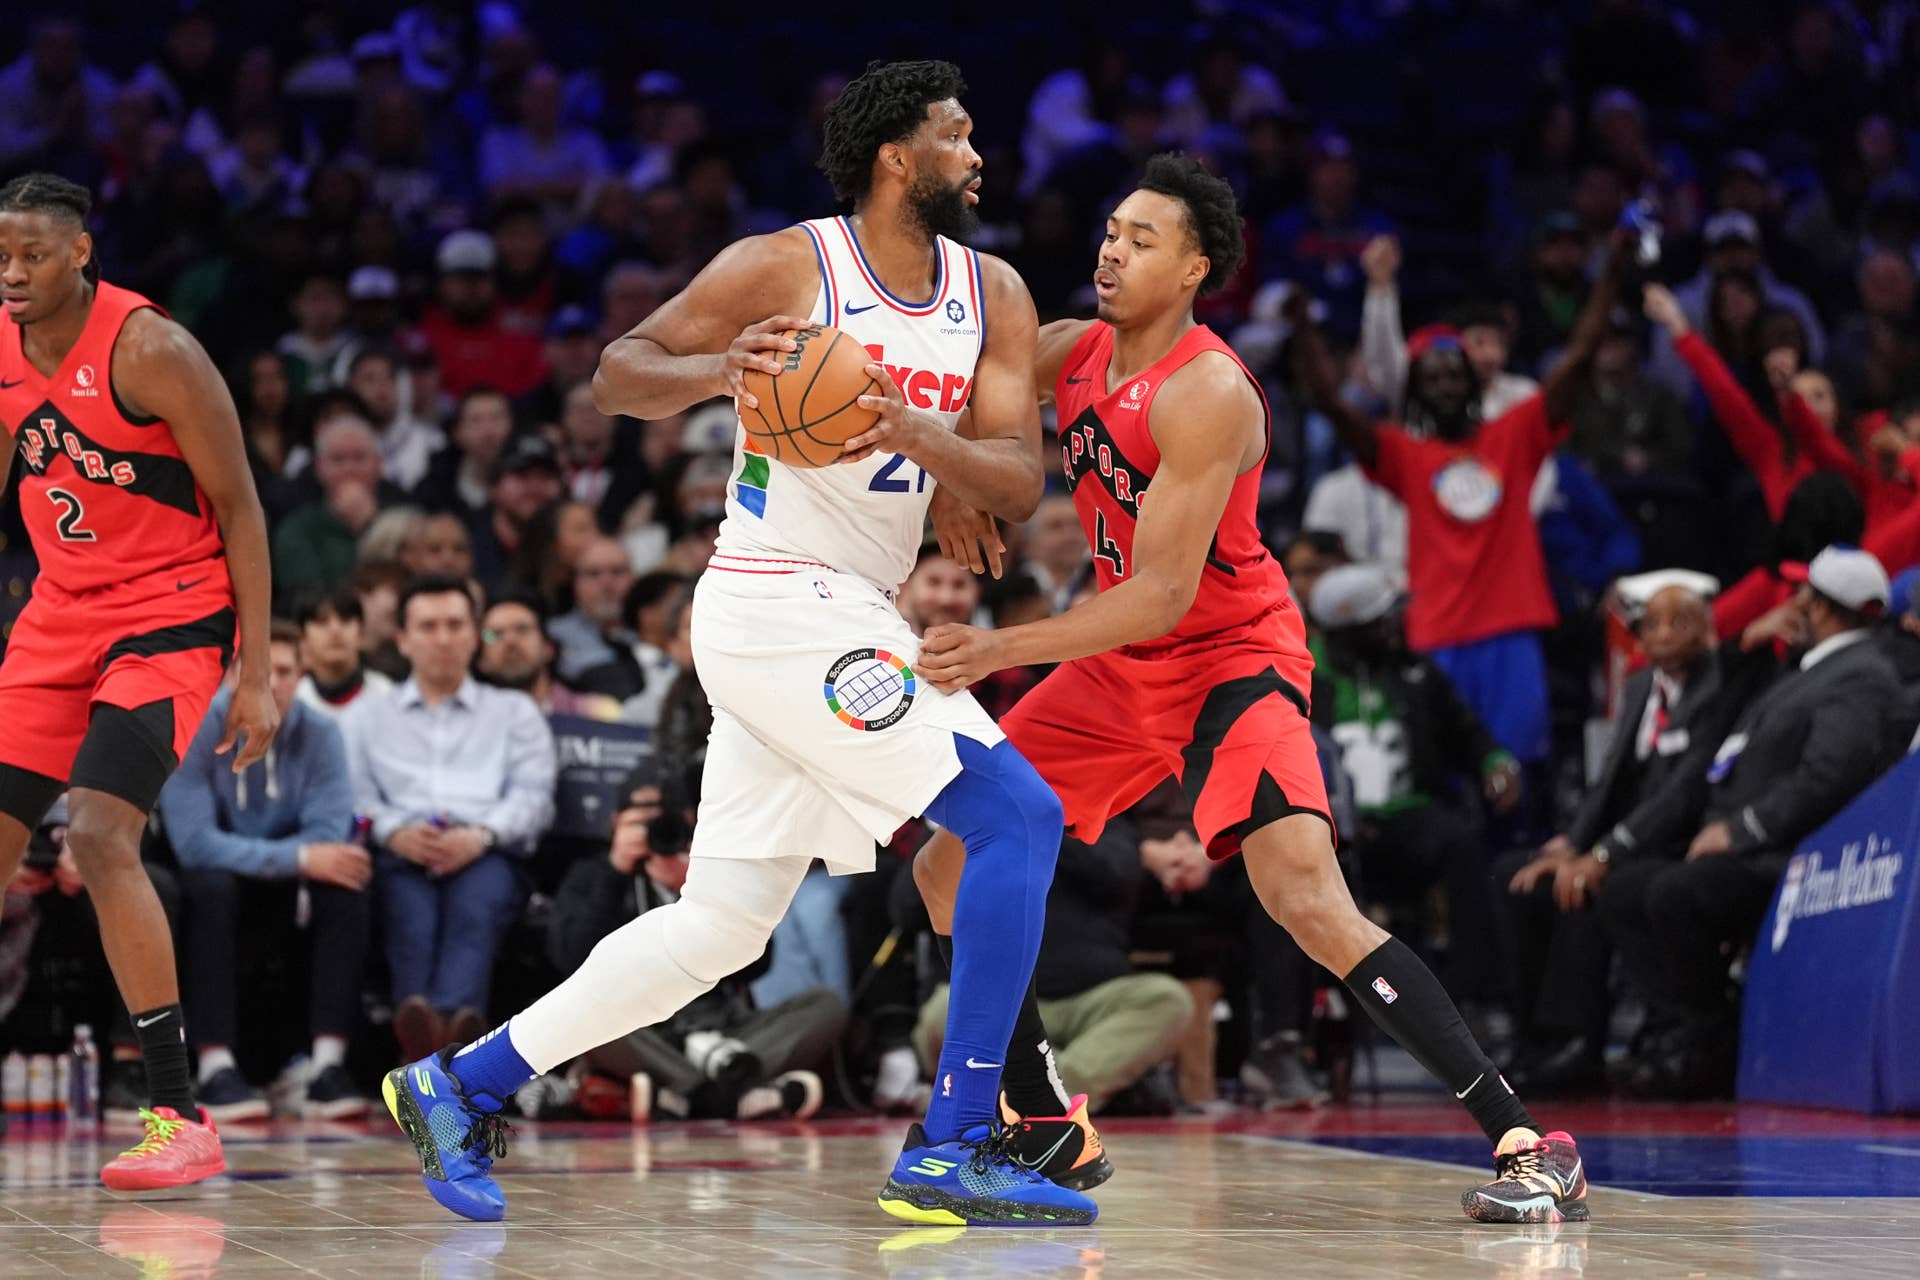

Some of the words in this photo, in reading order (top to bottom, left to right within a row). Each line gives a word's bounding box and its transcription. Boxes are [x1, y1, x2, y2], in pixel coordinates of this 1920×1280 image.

[20, 419, 136, 486] APTORS
[1061, 425, 1146, 508] APTOR
[46, 487, 97, 542] 2
[1093, 507, 1124, 577] 4
[829, 651, 869, 679] Spectrum
[870, 700, 909, 729] Spectrum
